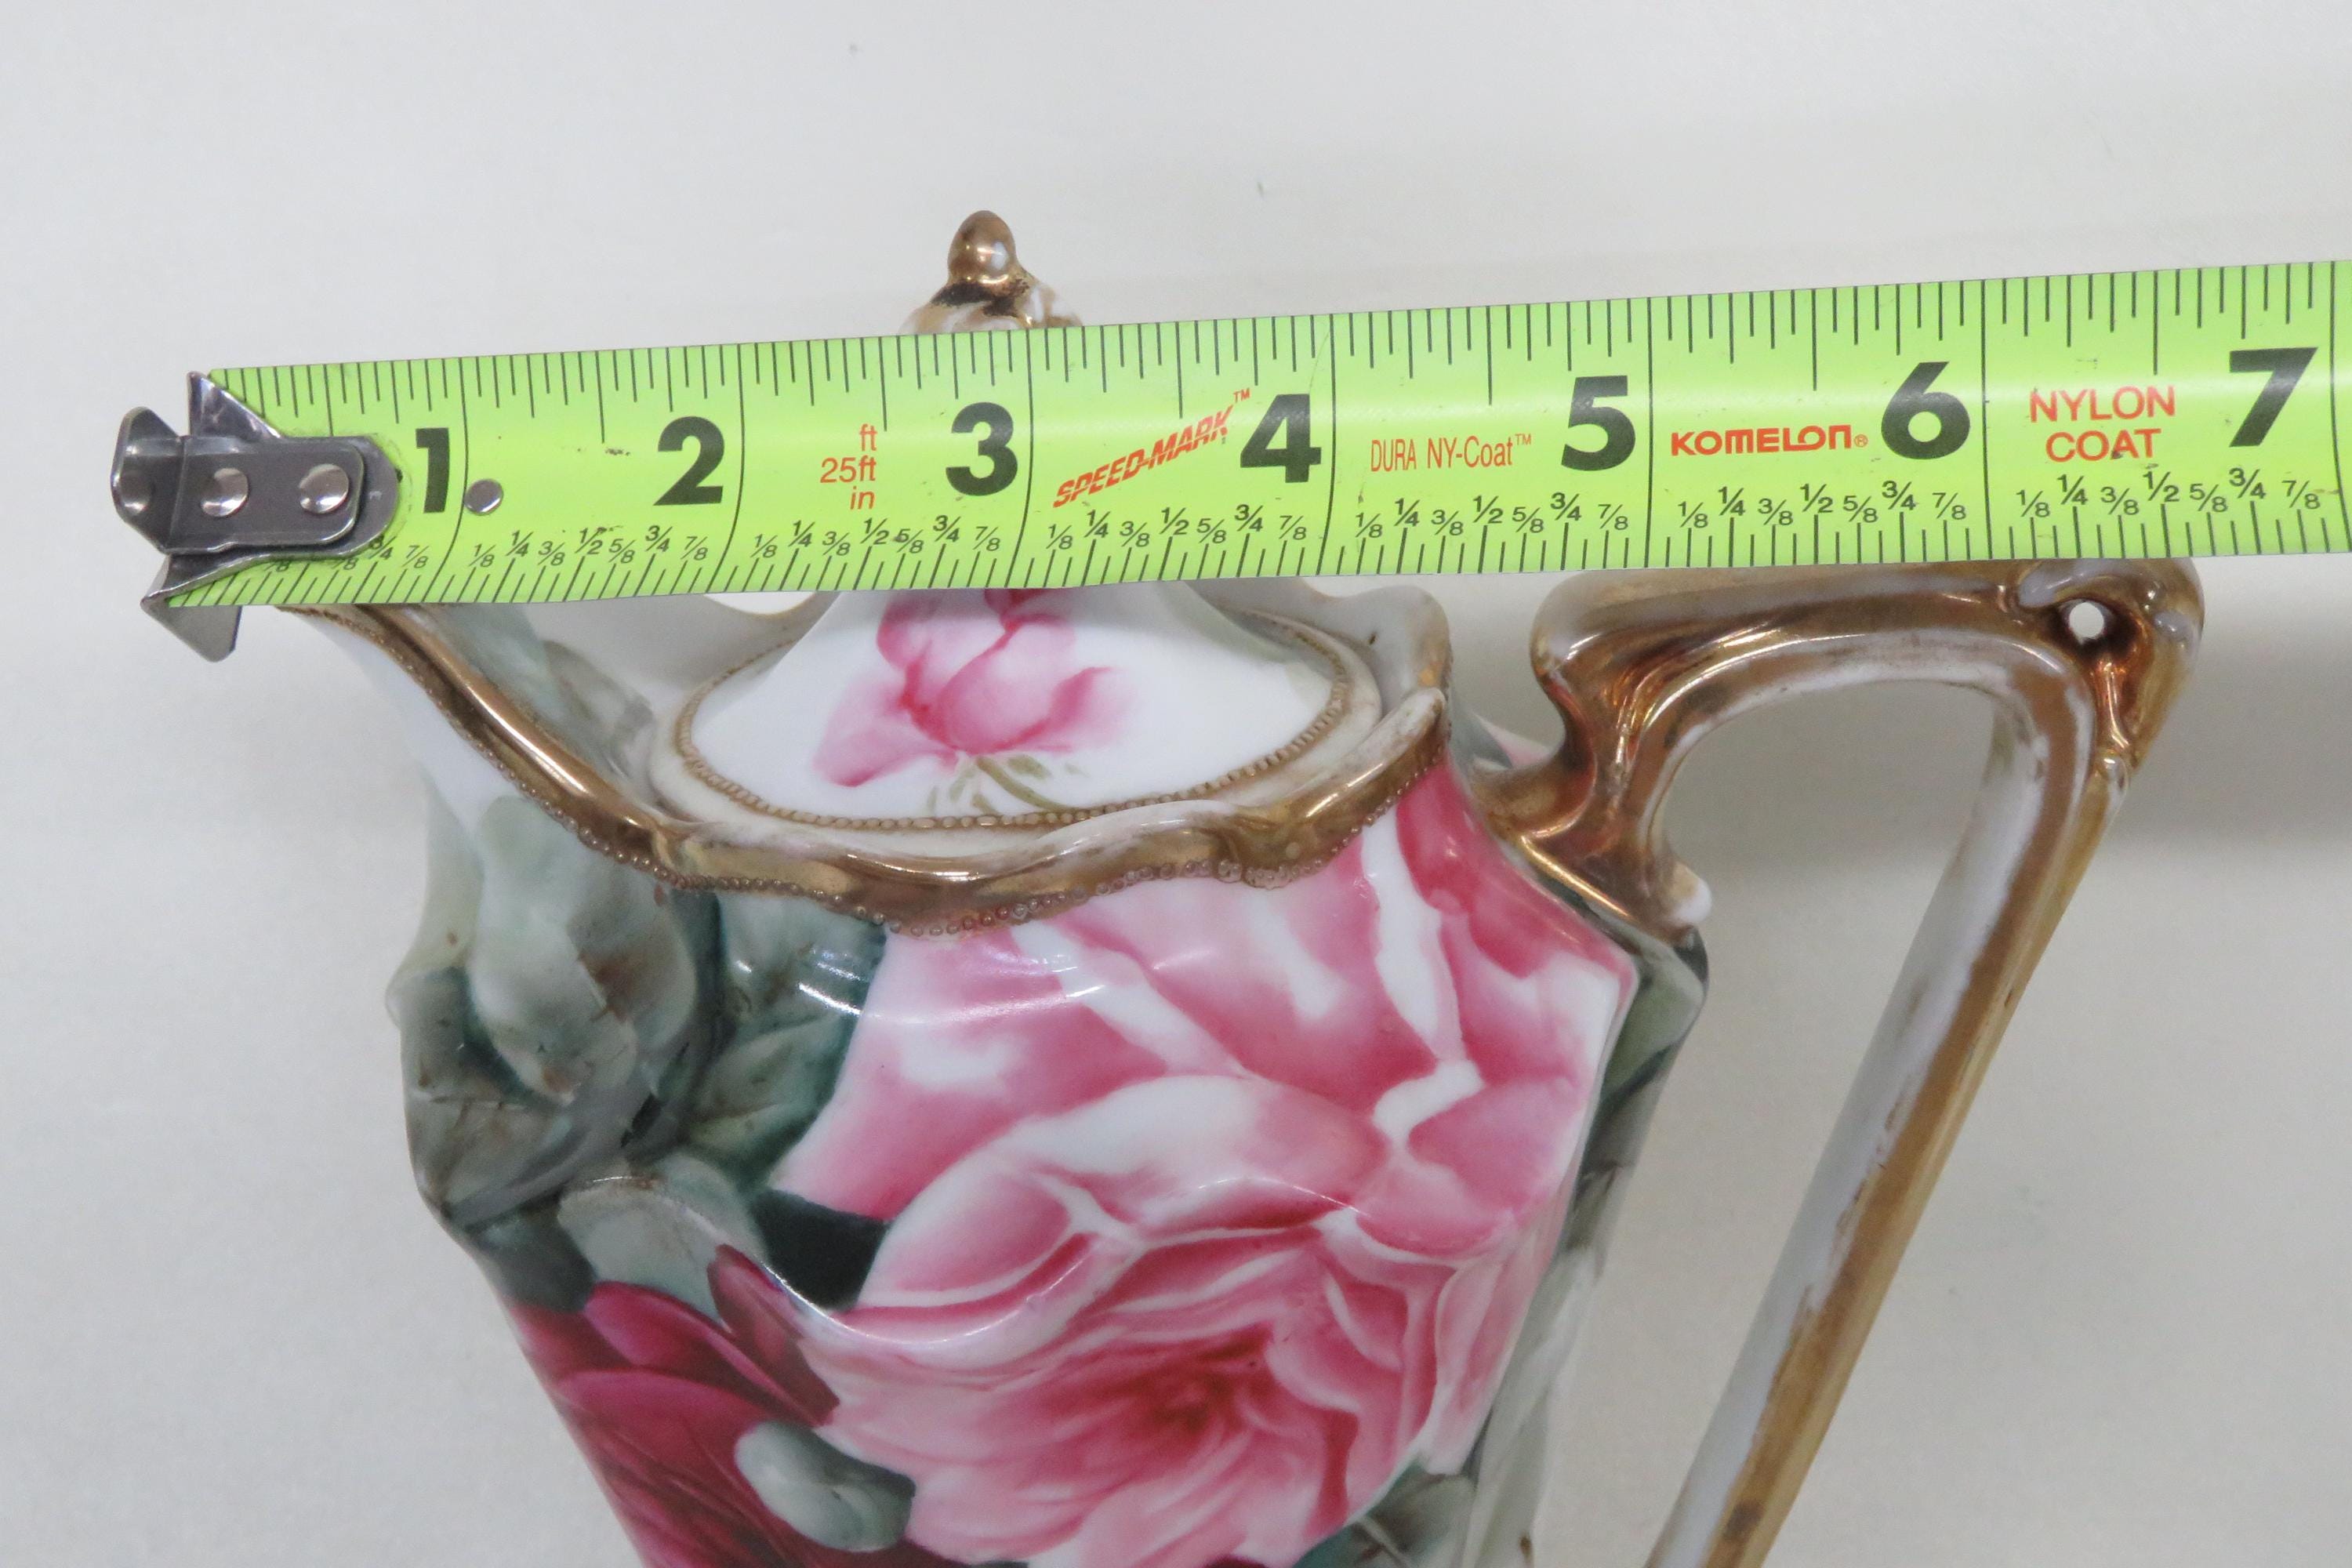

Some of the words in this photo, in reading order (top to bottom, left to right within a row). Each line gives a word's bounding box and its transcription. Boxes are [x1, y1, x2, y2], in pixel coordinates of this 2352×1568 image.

[1881, 361, 1970, 460] 6
[2029, 386, 2176, 423] NYLON
[2229, 347, 2319, 448] 7
[859, 423, 877, 452] ft
[1240, 394, 1322, 483] 4
[1560, 375, 1636, 471] 5
[2045, 428, 2161, 463] COAT
[415, 427, 449, 514] 1
[652, 416, 725, 506] 2
[820, 456, 877, 484] 25ft
[946, 401, 1018, 496] 3
[1370, 438, 1417, 472] DURA
[850, 486, 875, 510] in
[1356, 513, 1383, 539] 1/8
[1394, 499, 1420, 527] 1/4
[1431, 510, 1464, 535] 3/8
[1472, 495, 1504, 524] 1/2
[1512, 506, 1544, 533] 5/8
[1550, 492, 1581, 521] 3/4
[1599, 504, 1628, 530] 7/8
[1678, 502, 1708, 528] 1/8
[1719, 486, 1746, 517] 1/4
[1758, 499, 1794, 525] 3/8
[1800, 484, 1834, 513] 1/2
[1842, 495, 1878, 523] 5/8
[1882, 481, 1916, 510] 3/4
[1932, 492, 1966, 521] 7/8
[2016, 490, 2050, 517] 1/8
[2057, 474, 2089, 505] 1/4
[2100, 487, 2140, 515] 3/8
[2143, 471, 2180, 502] 1/2
[2190, 483, 2228, 512] 5/8
[2229, 467, 2266, 499] 3/4
[2281, 480, 2321, 510] 7/8
[469, 543, 496, 568] 1/8
[504, 530, 534, 557] 1/4
[539, 542, 566, 566] 3/8
[576, 528, 604, 557] 1/2
[608, 536, 636, 564] 5/8
[645, 525, 673, 552] 3/4
[682, 536, 709, 561] 7/8
[750, 534, 779, 558] 1/8
[789, 520, 815, 546] 1/4
[822, 531, 851, 556] 3/8
[861, 517, 890, 545] 1/2
[894, 528, 924, 554] 5/8
[933, 514, 960, 542] 3/4
[973, 526, 1001, 551] 7/8
[1046, 524, 1073, 550] 1/8
[1084, 510, 1111, 538] 1/4
[1120, 521, 1150, 547] 3/8
[1160, 507, 1189, 535] 1/2
[1196, 518, 1226, 544] 5/8
[1235, 504, 1263, 532] 3/4
[1279, 515, 1307, 540] 7/8
